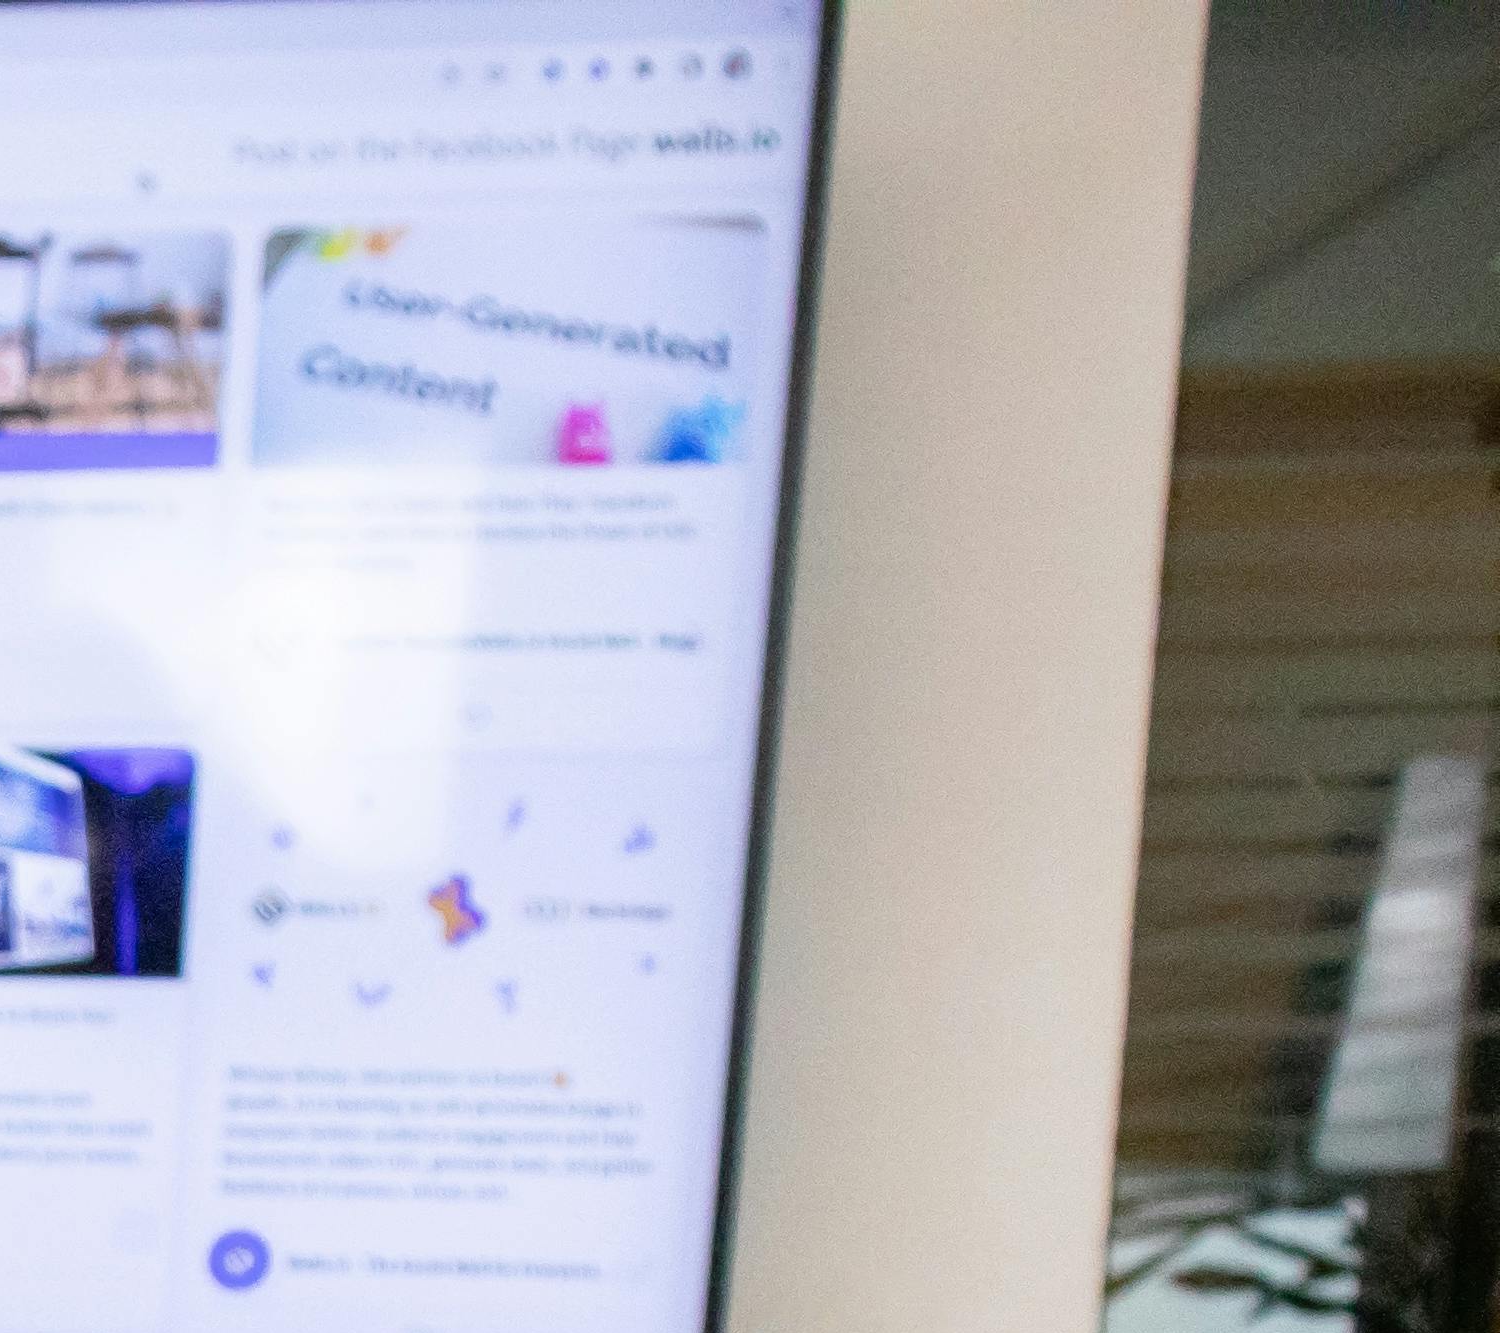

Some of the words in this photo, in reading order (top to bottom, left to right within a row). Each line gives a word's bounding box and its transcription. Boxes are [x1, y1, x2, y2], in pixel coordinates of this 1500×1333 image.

[653, 125, 781, 156] walls.io
[342, 277, 732, 372] User-Generated
[301, 342, 497, 414] Content
